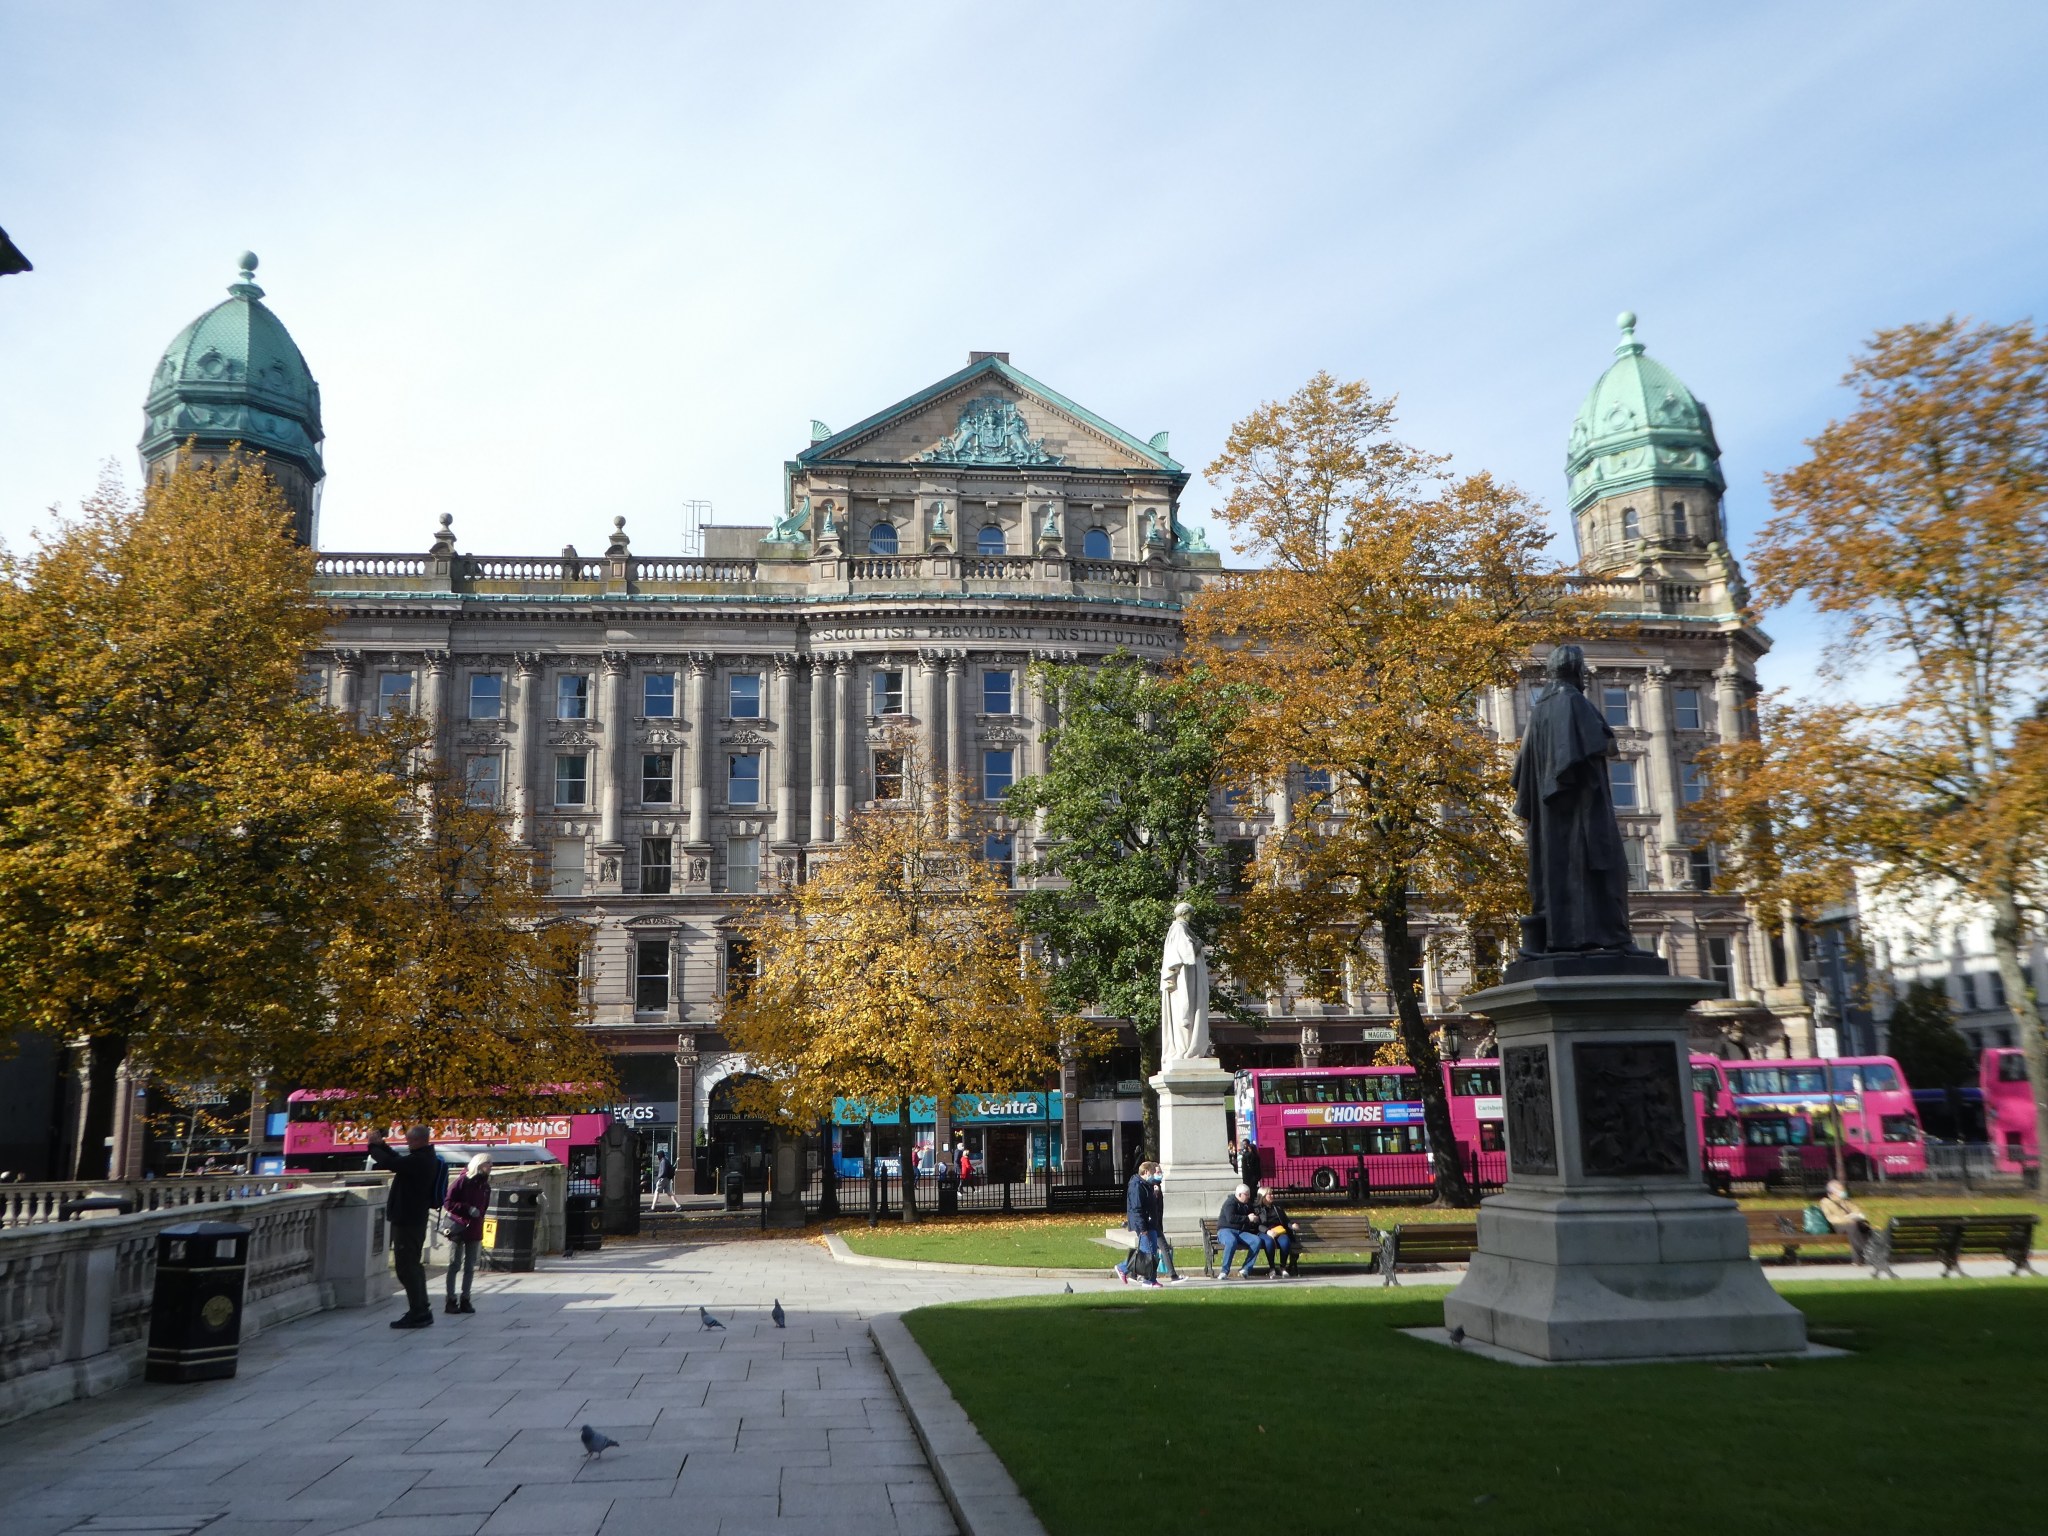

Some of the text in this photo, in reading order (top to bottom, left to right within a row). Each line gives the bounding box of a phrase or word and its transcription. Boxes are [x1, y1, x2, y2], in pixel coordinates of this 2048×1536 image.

[822, 625, 1167, 648] SCOTTISH PROVIDENT INSTITUTION
[1367, 1031, 1392, 1039] MAGGIES
[977, 1100, 1038, 1115] Centra
[1324, 1104, 1382, 1123] CHOOSE
